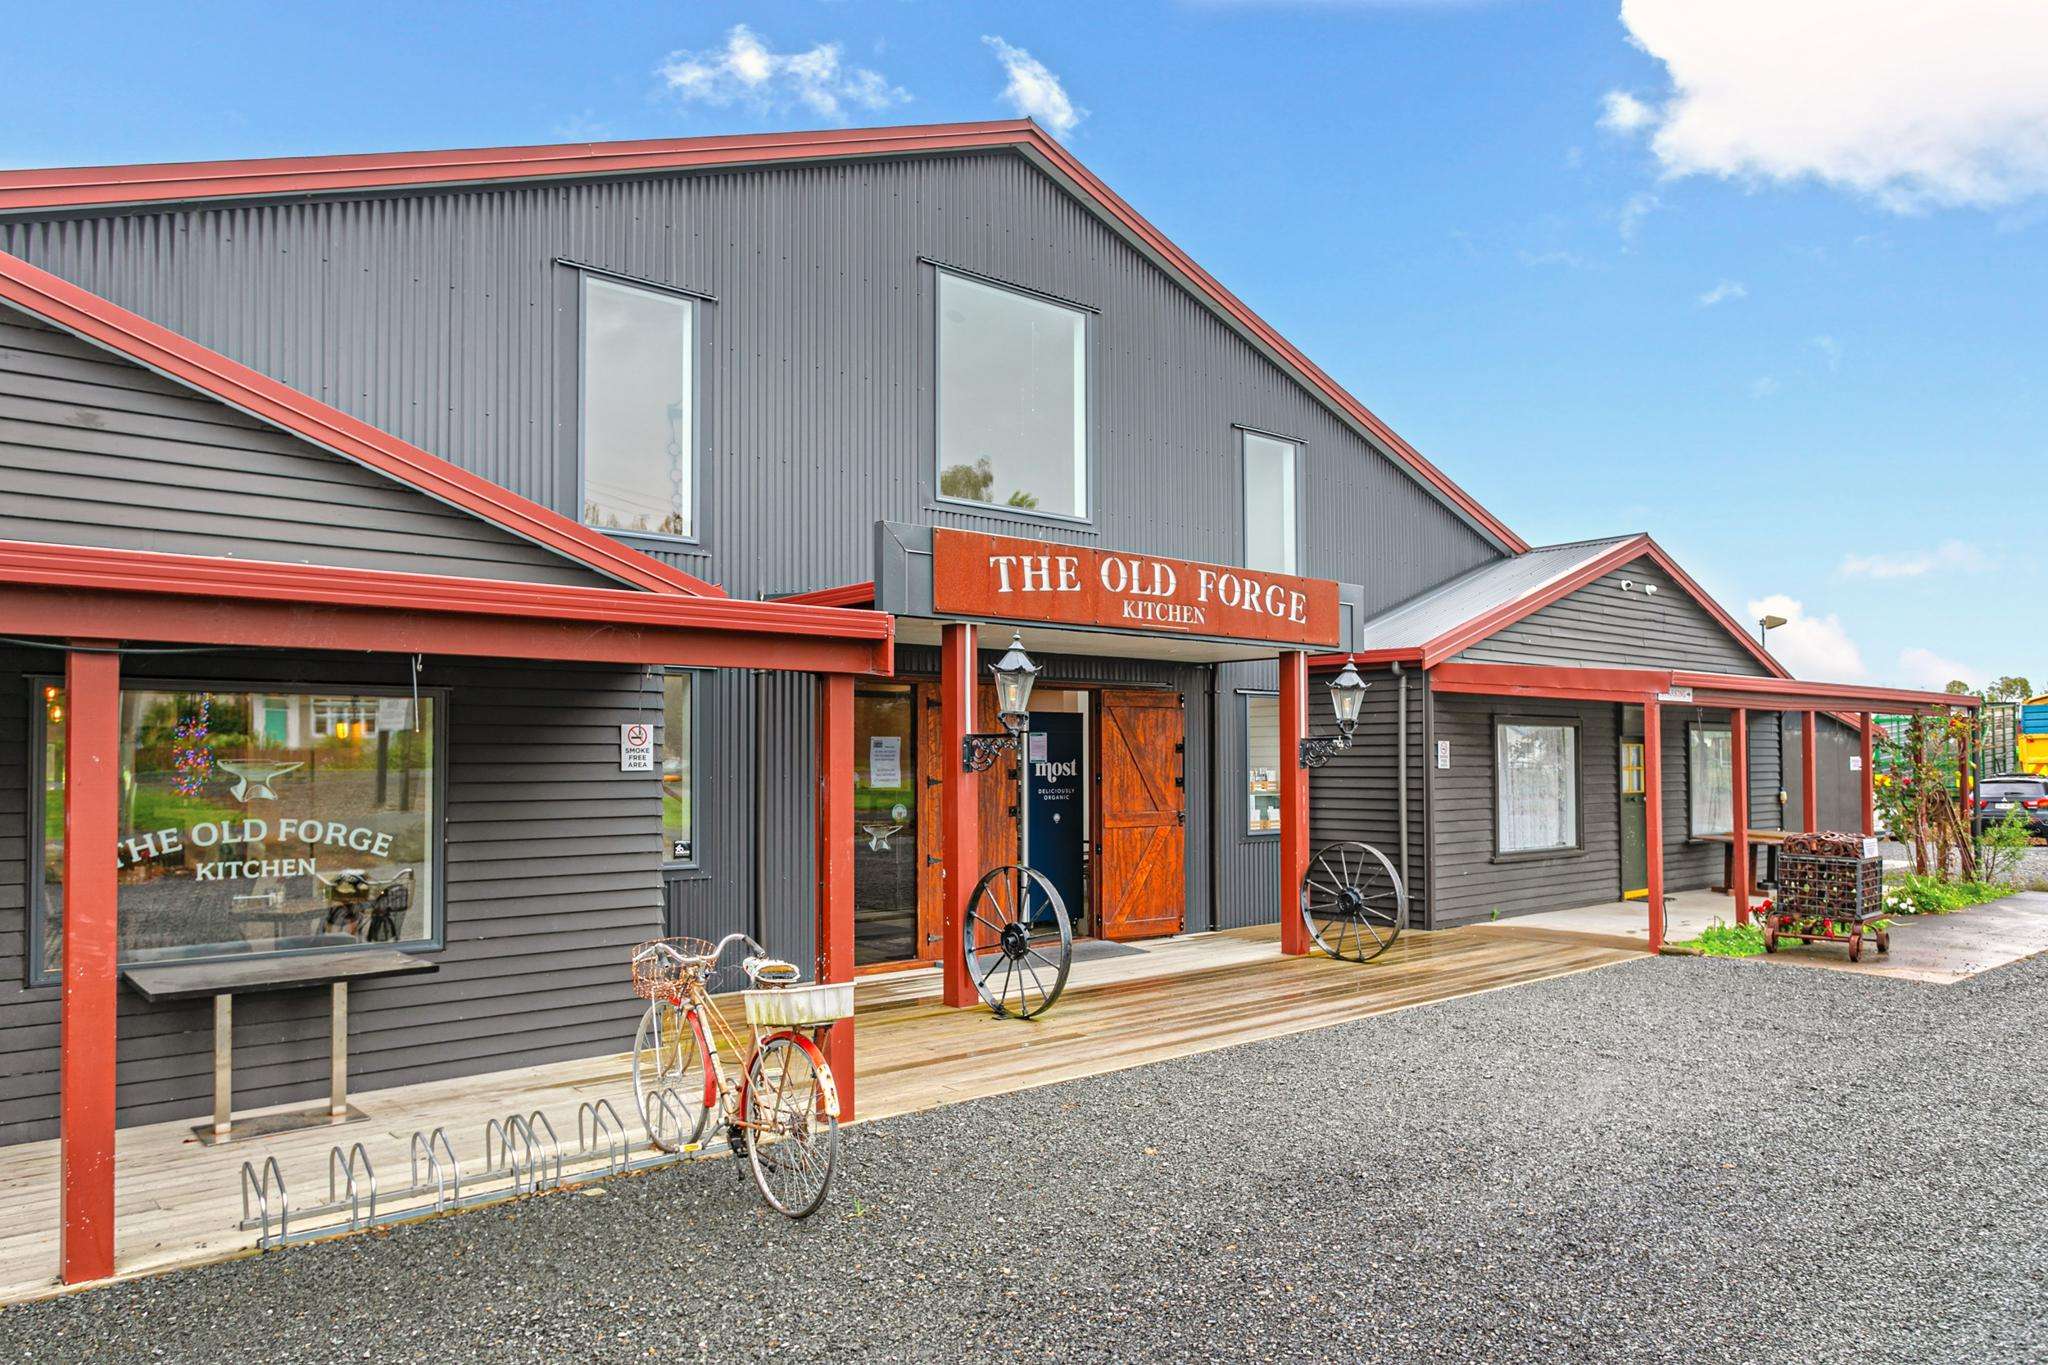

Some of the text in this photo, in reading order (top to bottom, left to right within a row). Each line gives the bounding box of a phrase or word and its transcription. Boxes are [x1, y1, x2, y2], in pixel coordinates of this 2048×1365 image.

[989, 555, 1308, 625] THE OLD FORGE
[1122, 599, 1207, 626] KITCHEN
[1035, 758, 1078, 783] most
[191, 818, 268, 847] OLD
[278, 818, 394, 858] FORGE
[195, 857, 317, 882] KITCHEN
